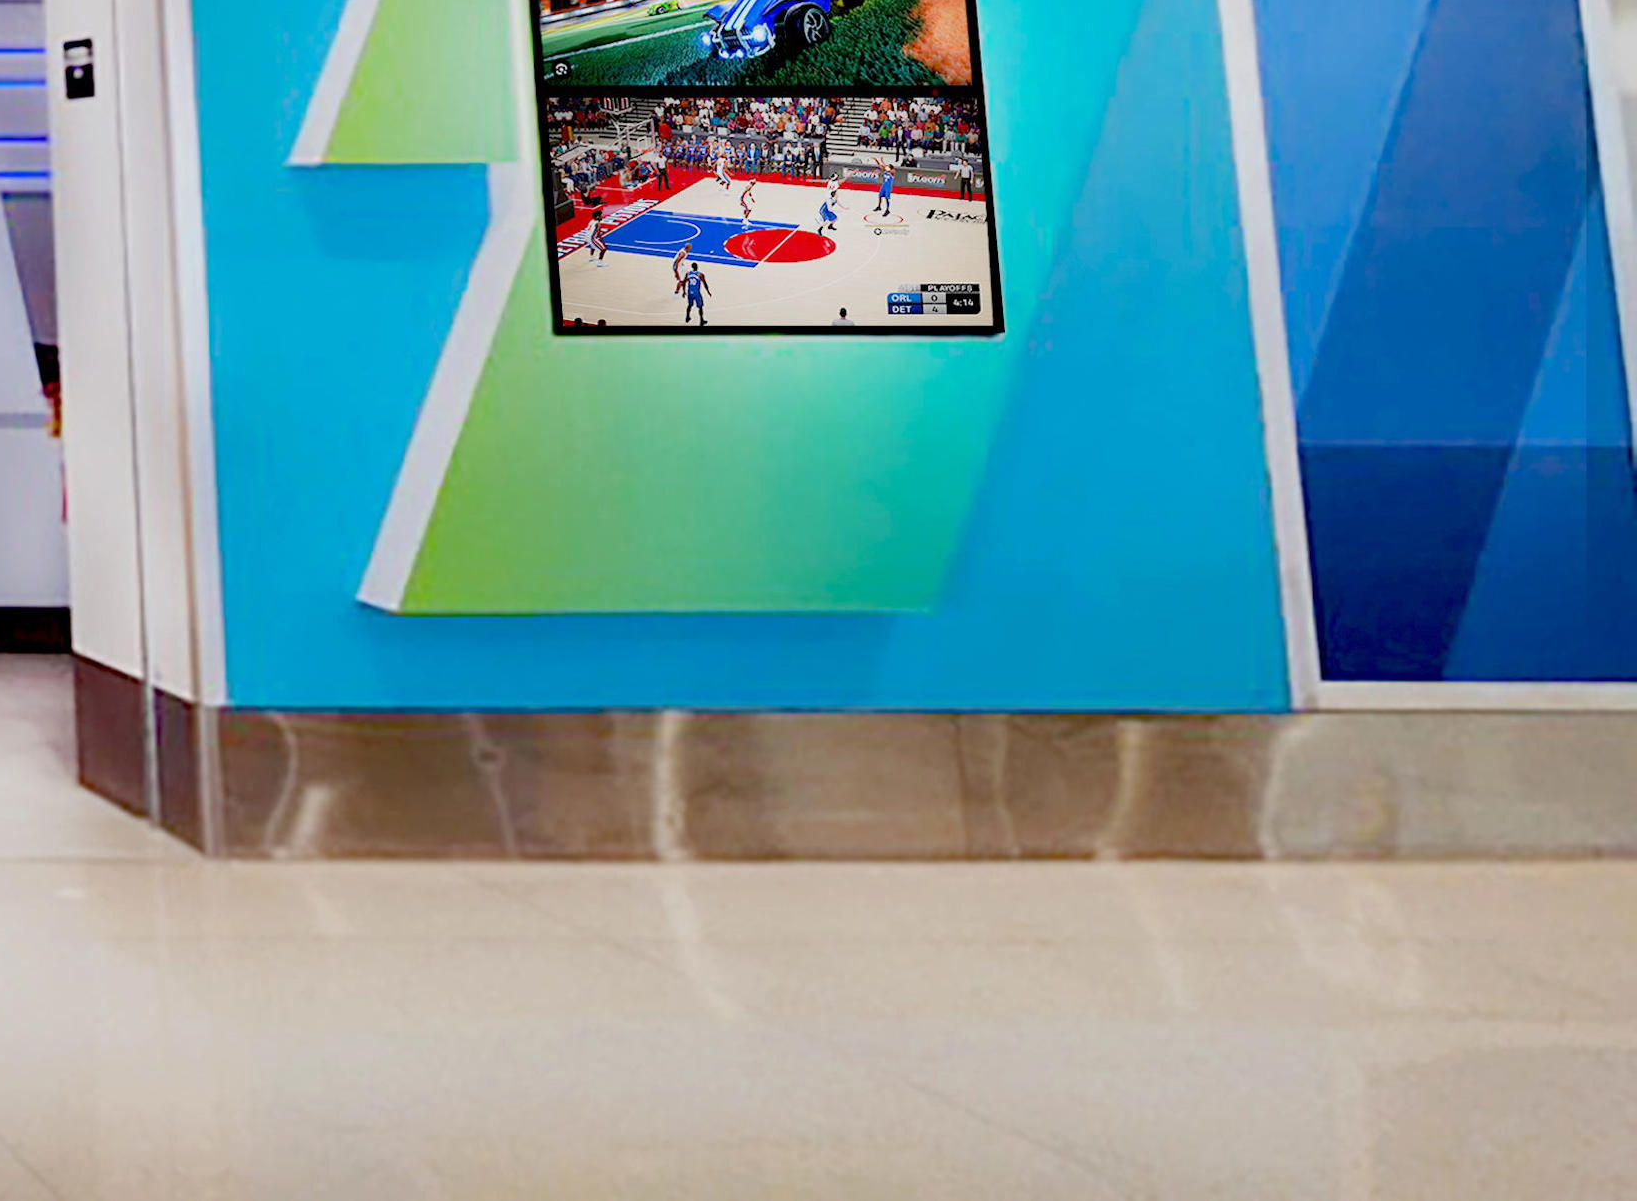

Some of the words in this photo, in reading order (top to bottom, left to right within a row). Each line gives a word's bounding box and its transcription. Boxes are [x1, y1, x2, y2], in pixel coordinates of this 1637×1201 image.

[927, 284, 973, 292] PLAYOFFS
[891, 294, 912, 303] ORL
[953, 299, 974, 307] 4:14
[892, 305, 912, 314] DET
